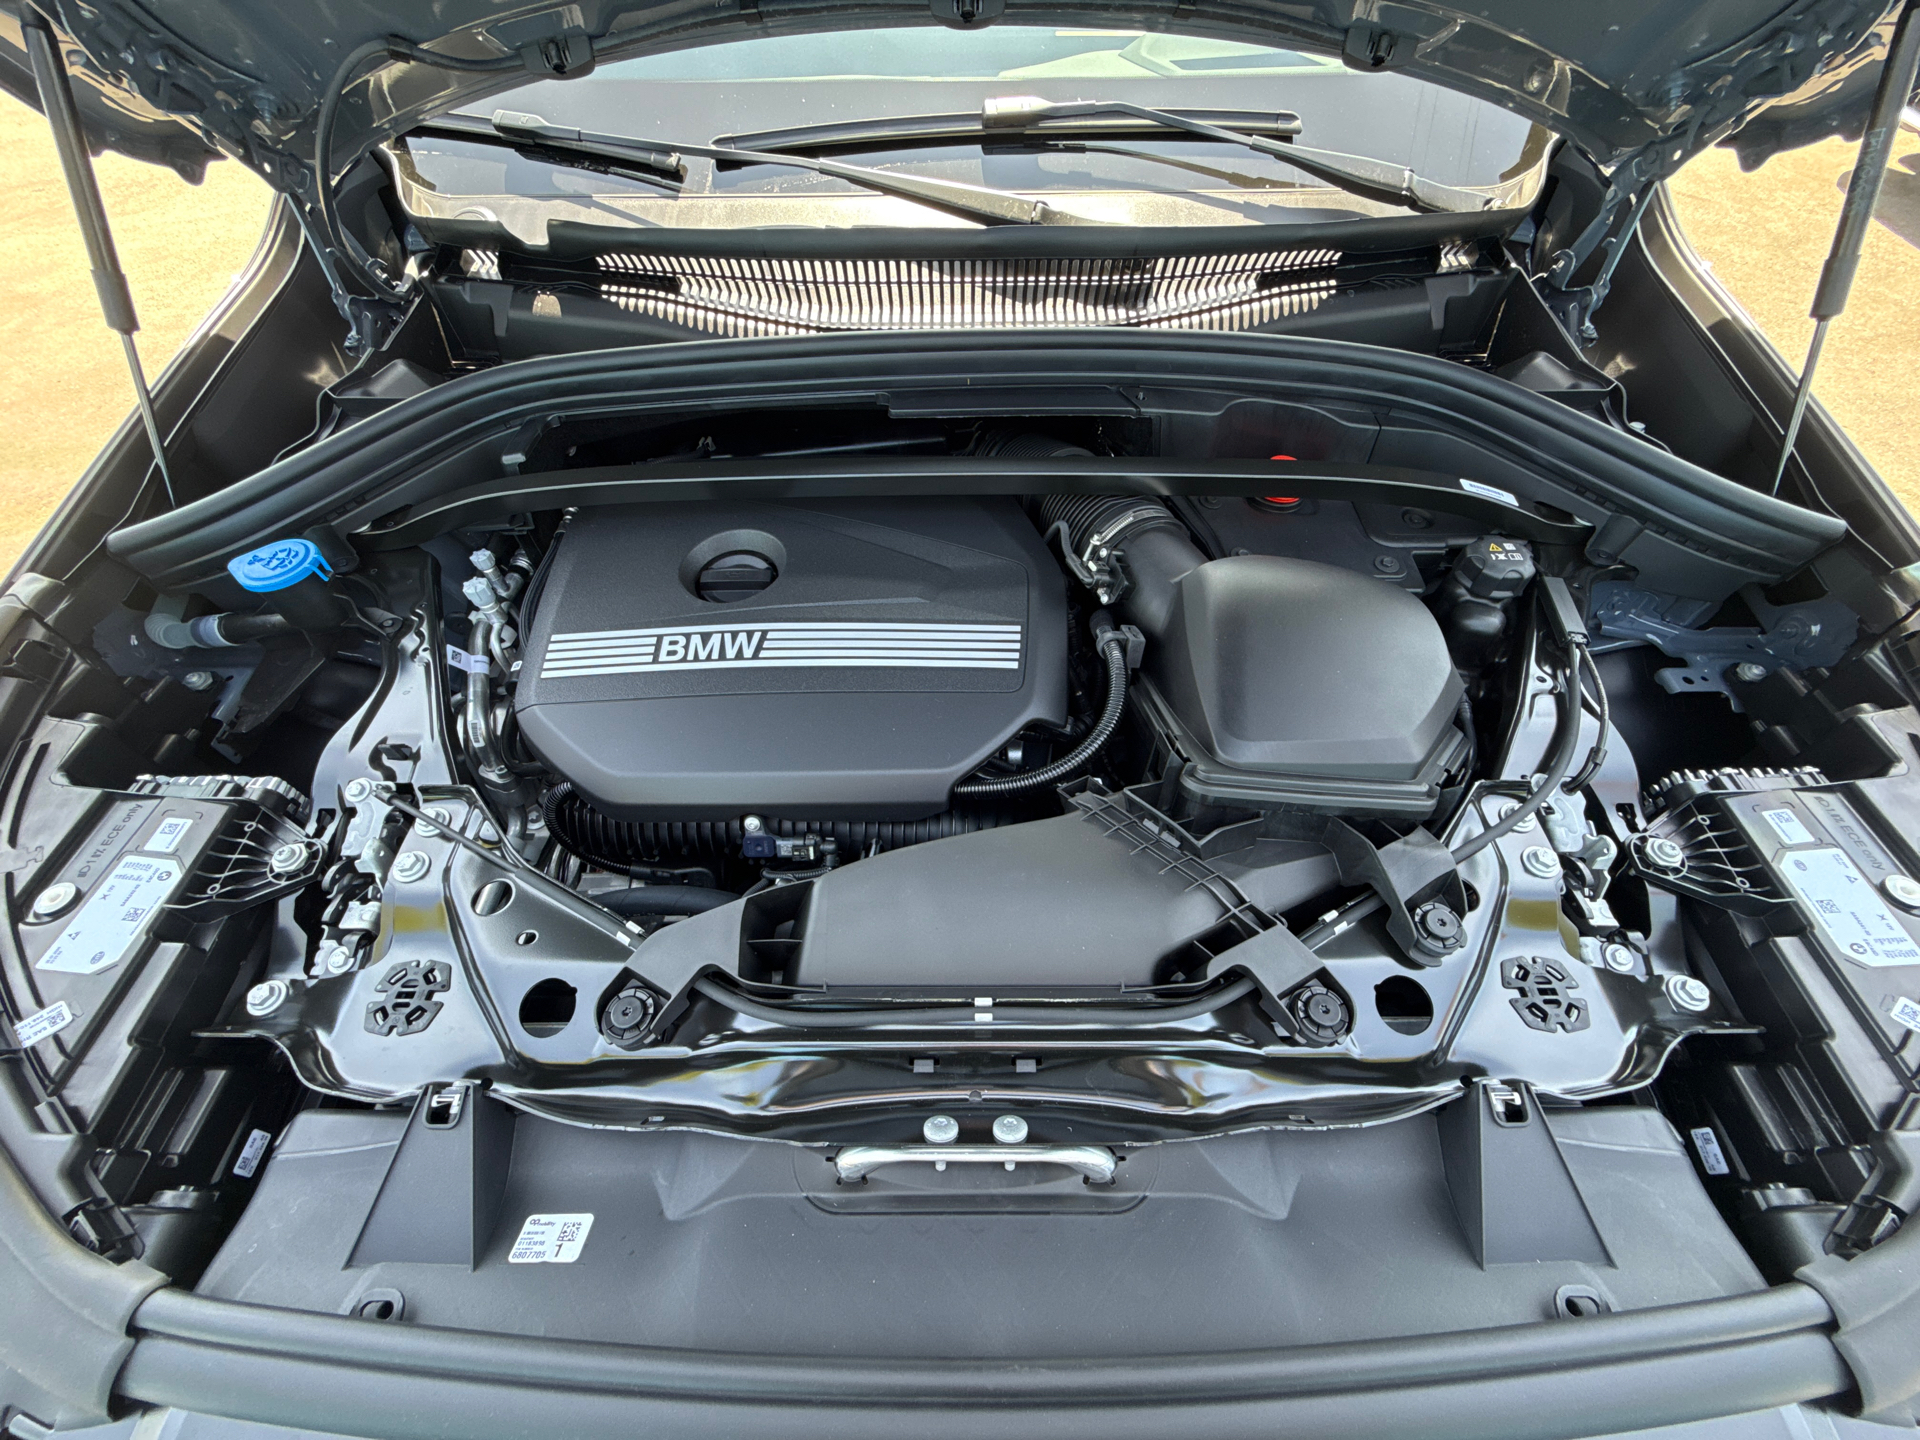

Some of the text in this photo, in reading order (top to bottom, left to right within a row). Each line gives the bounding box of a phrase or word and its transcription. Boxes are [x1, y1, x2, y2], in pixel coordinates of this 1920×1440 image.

[658, 631, 762, 662] BMW
[101, 824, 126, 846] ECE
[122, 803, 143, 823] only
[1840, 825, 1868, 848] ECE
[1862, 849, 1886, 871] only
[554, 1242, 564, 1258] 1
